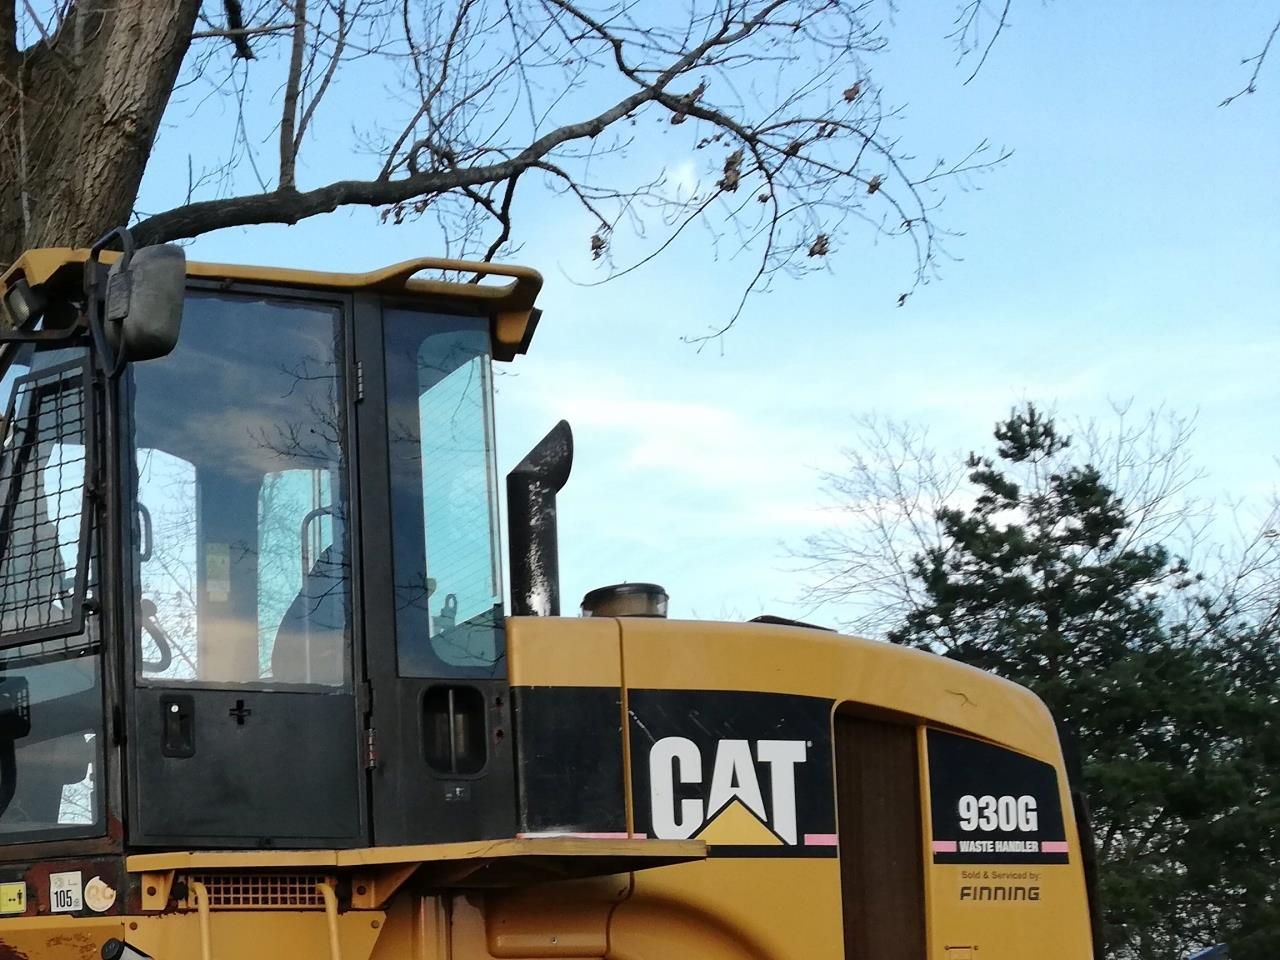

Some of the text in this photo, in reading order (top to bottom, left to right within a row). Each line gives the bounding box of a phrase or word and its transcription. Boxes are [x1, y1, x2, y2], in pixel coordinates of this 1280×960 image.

[649, 736, 807, 846] CAT
[958, 794, 1039, 832] 930G
[959, 840, 1040, 853] WASTE HANDLER
[961, 870, 980, 880] Sold
[982, 870, 990, 880] &
[991, 870, 1027, 880] Serviced
[54, 889, 72, 908] 105
[959, 886, 1041, 901] FINNING
